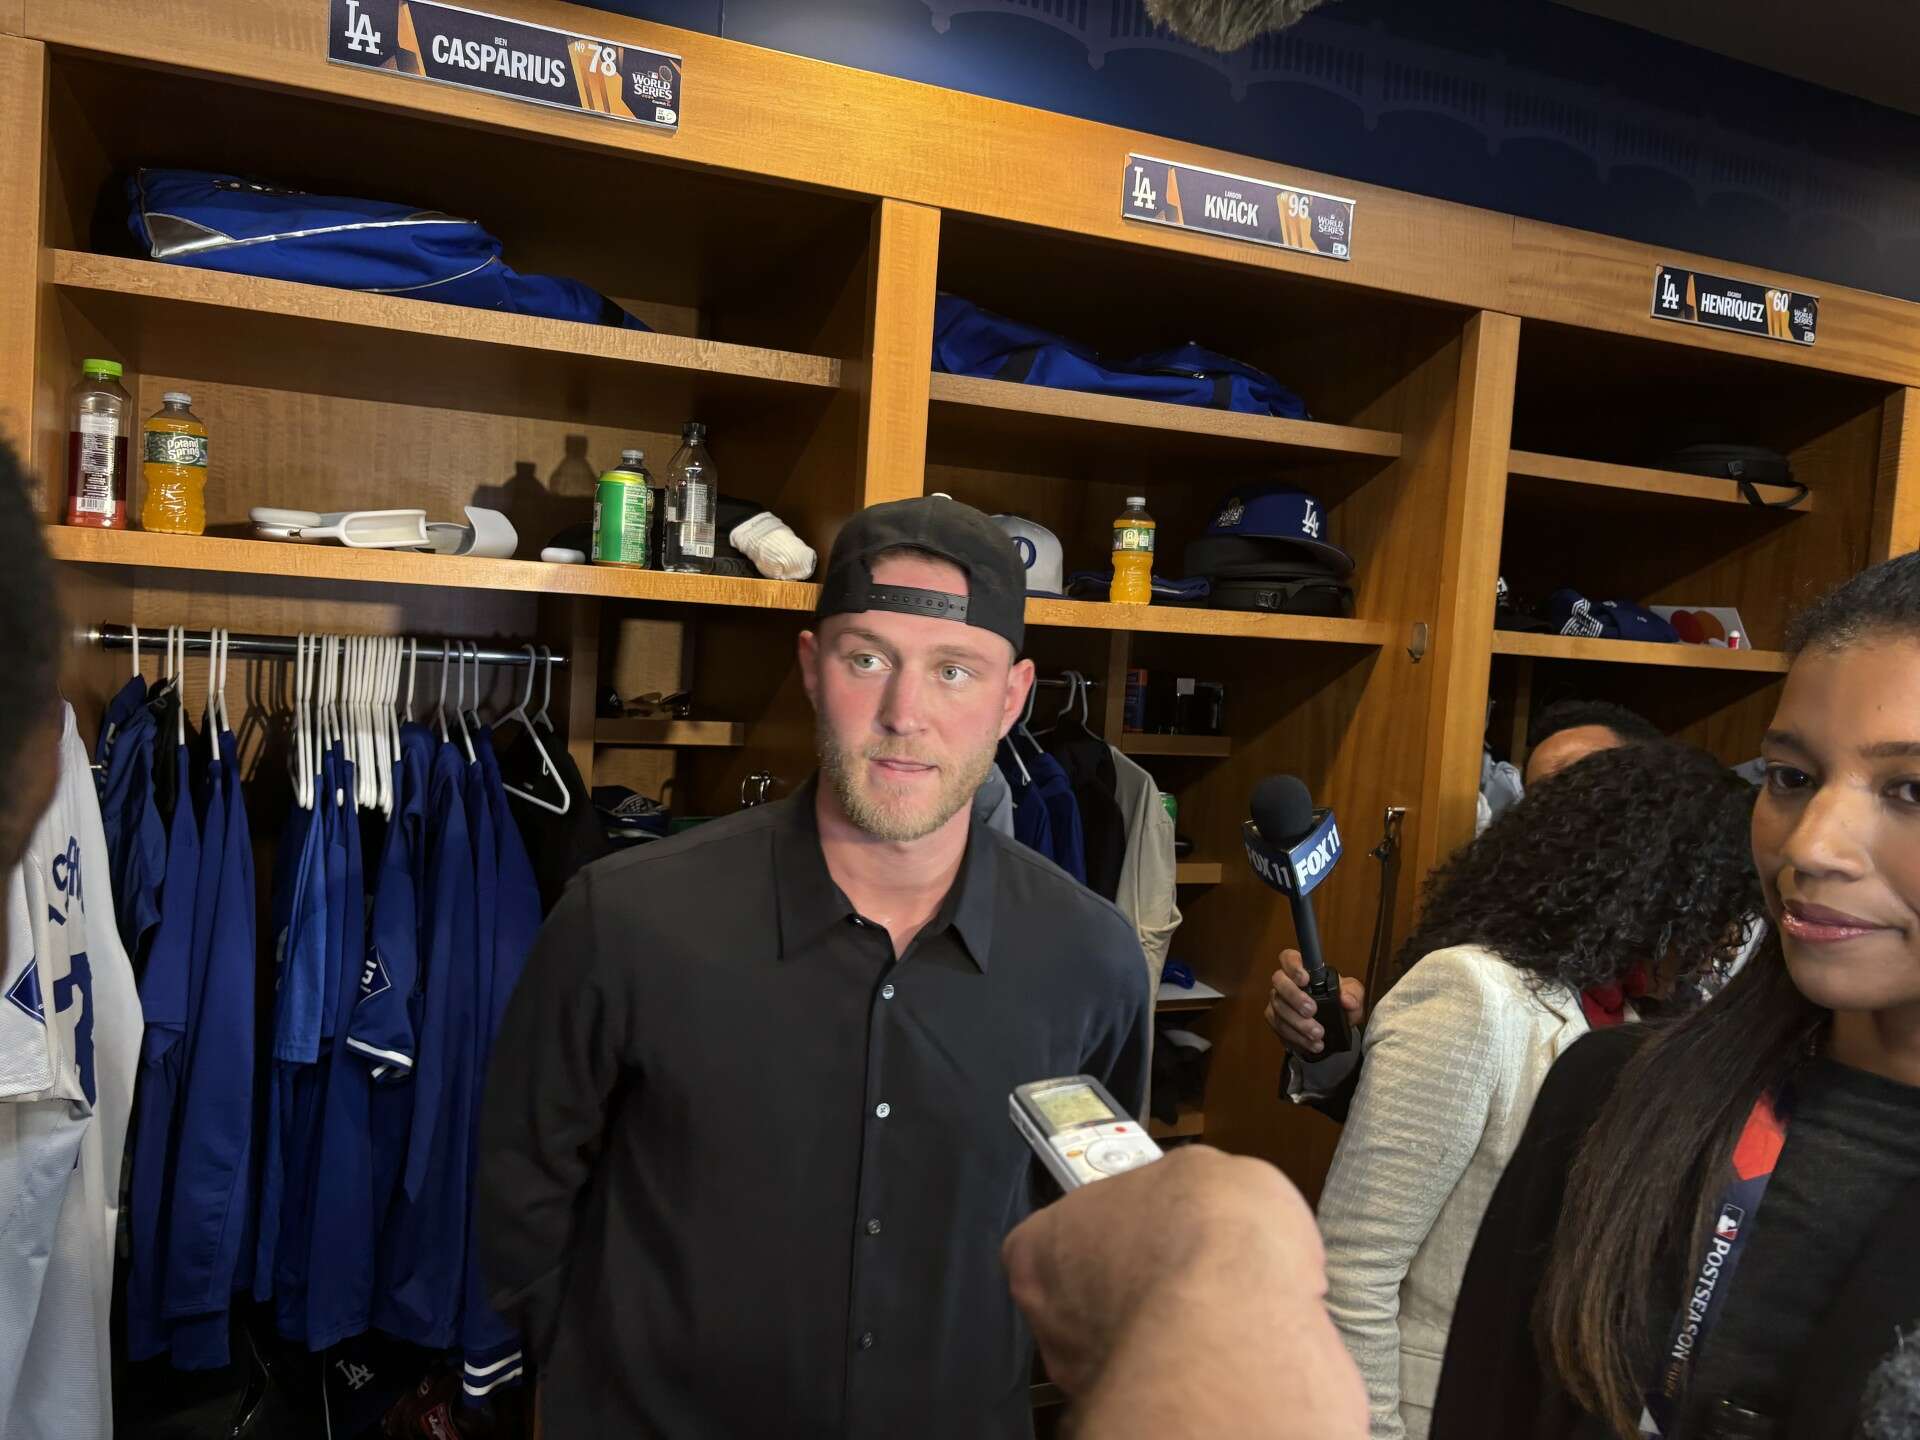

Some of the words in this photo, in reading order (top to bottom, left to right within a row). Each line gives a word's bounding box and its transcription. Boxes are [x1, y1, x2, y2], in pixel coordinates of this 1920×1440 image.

[344, 0, 381, 55] LA
[494, 36, 508, 47] BEN
[432, 34, 566, 88] CASPARIUS
[587, 43, 617, 77] 78
[631, 72, 671, 90] WORLD
[633, 84, 673, 100] SERIES
[1132, 166, 1157, 210] LA
[1204, 194, 1259, 227] KNACK
[1288, 193, 1310, 219] 96
[1317, 215, 1344, 231] WORLD
[1318, 223, 1345, 236] SERIES
[1661, 274, 1680, 310] LA
[1700, 292, 1765, 323] HENRIQUEZ
[1772, 290, 1789, 313] 60
[167, 437, 199, 450] Poland
[167, 447, 200, 460] Spring
[1301, 498, 1320, 539] LA
[1295, 838, 1332, 887] FOX
[1671, 1237, 1732, 1362] POSTSEASON
